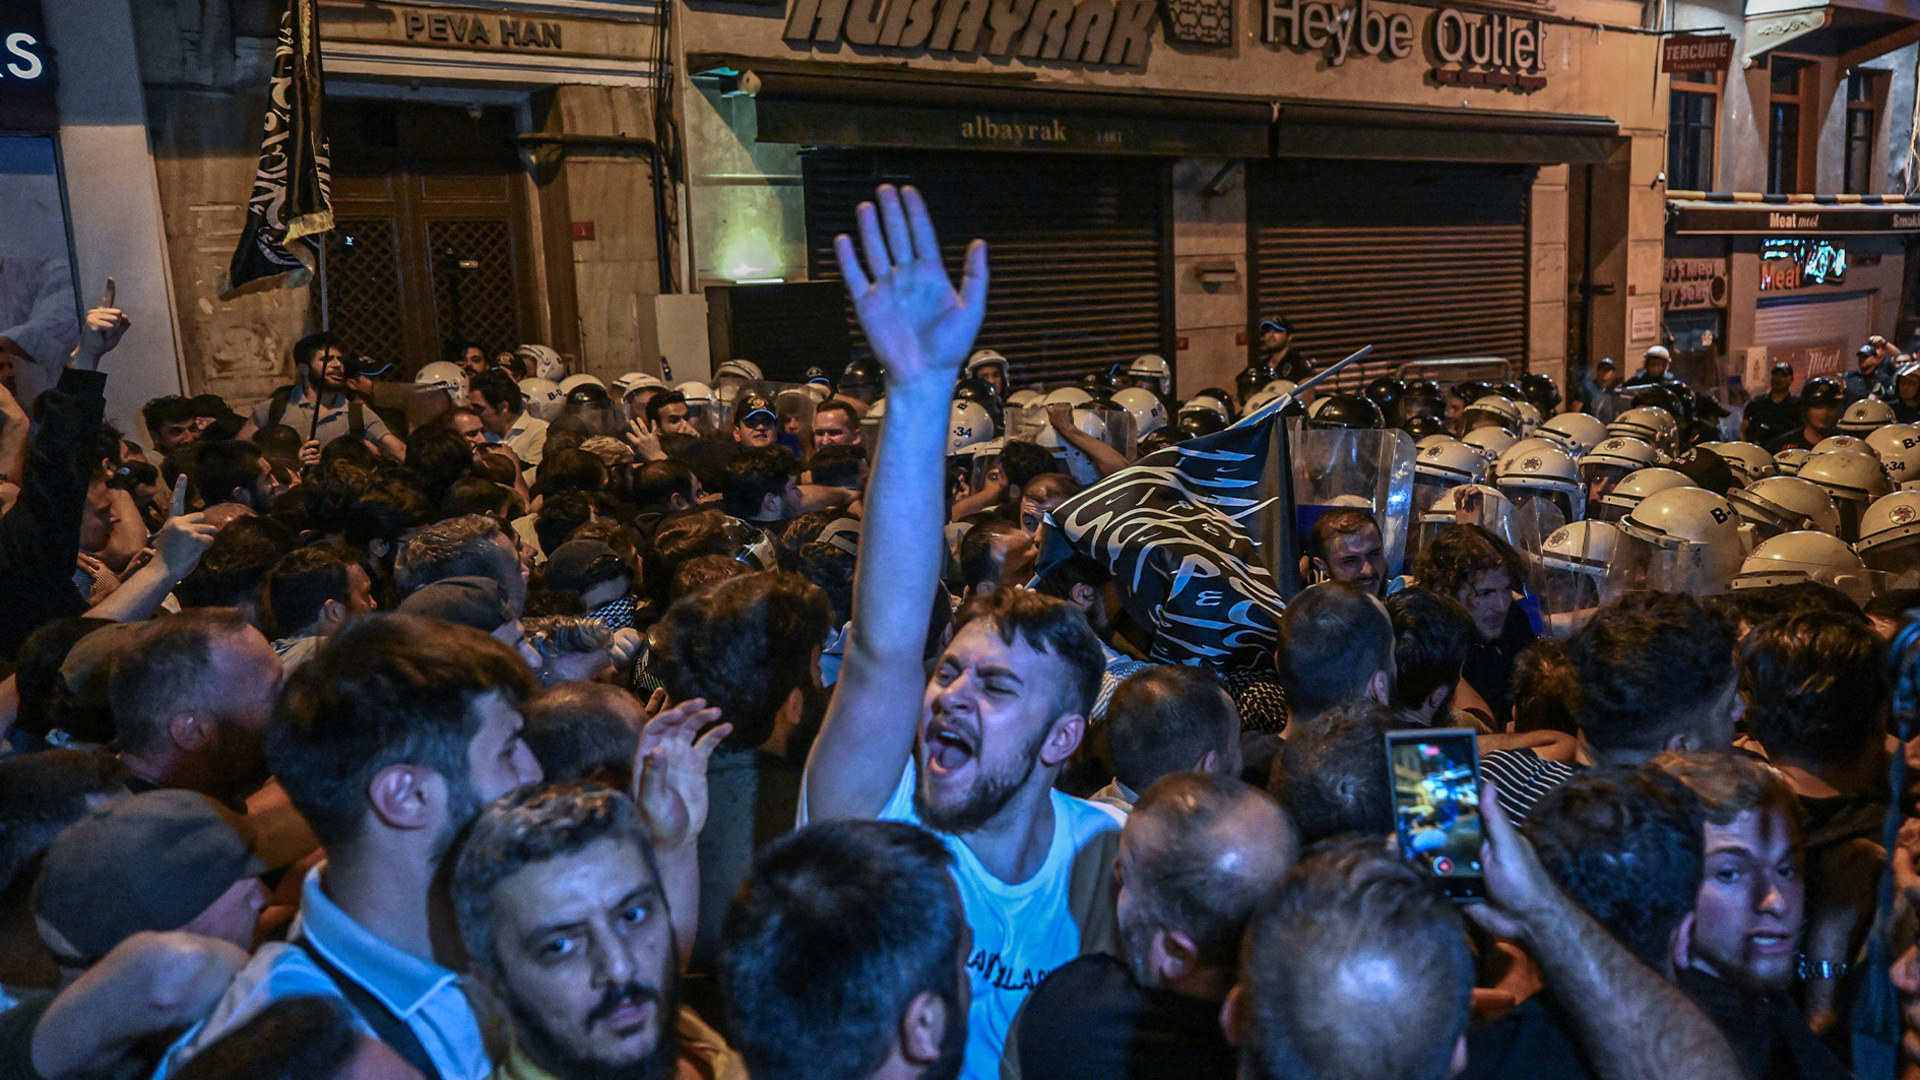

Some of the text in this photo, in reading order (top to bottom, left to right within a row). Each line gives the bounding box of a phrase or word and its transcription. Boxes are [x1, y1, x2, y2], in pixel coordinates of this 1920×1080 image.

[404, 9, 562, 49] PEVA HAN
[1266, 0, 1547, 70] Heybe Outlet
[961, 115, 1066, 147] albayrak
[1769, 212, 1797, 228] Meat
[1760, 263, 1800, 290] Meat
[1889, 461, 1906, 471] 34
